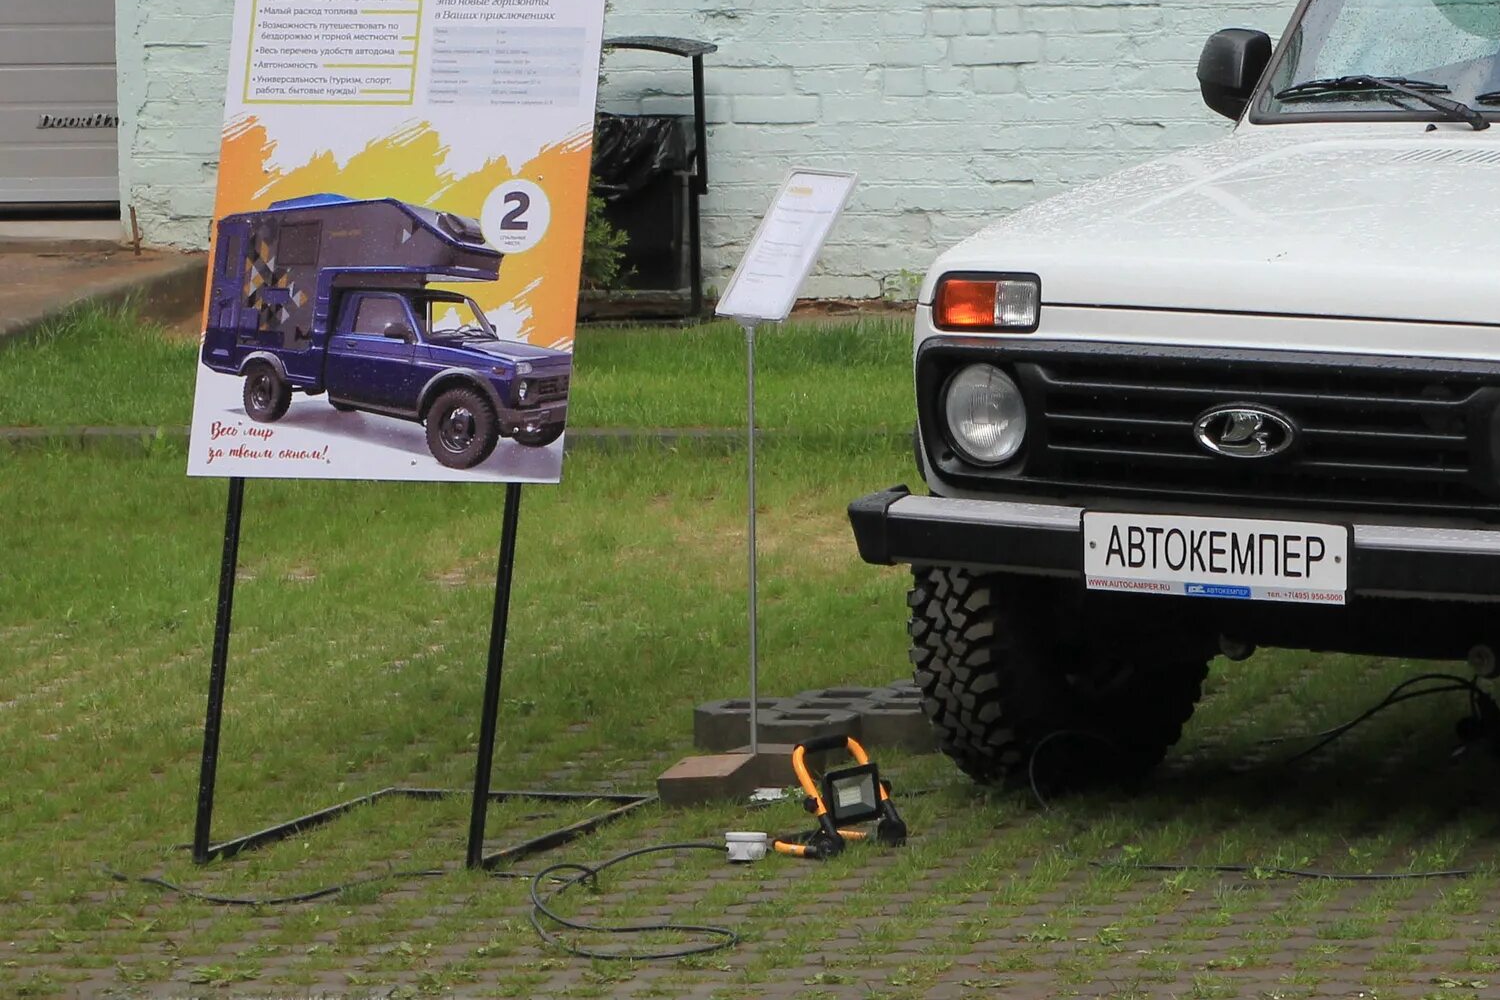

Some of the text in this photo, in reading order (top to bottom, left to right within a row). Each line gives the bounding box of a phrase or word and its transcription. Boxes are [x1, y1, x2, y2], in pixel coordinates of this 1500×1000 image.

[263, 7, 291, 15] Малый
[293, 8, 322, 17] расход
[442, 11, 477, 20] Ваших
[480, 12, 556, 21] приключениях
[262, 21, 317, 29] Возможность
[319, 22, 387, 31] путешествовать
[261, 32, 312, 42] бездорожью
[321, 33, 351, 42] горной
[280, 48, 318, 56] перечень
[319, 47, 355, 57] удобств
[355, 48, 395, 56] автодома
[257, 61, 318, 69] Автономность
[256, 76, 328, 85] Универсальность
[288, 86, 324, 94] бытовые
[326, 86, 357, 96] нужды)
[500, 191, 530, 230] 2
[211, 421, 274, 441] Весь мир
[206, 444, 329, 464] за твоим окном!
[1105, 525, 1326, 578] АВТОКЕМПЕР
[1087, 579, 1170, 591] WWW.AUTOCAMPER.RU
[1206, 586, 1249, 596] АВТОКЕМПЕР
[1283, 592, 1310, 600] +7(495)
[1311, 592, 1343, 602] 950-5000
